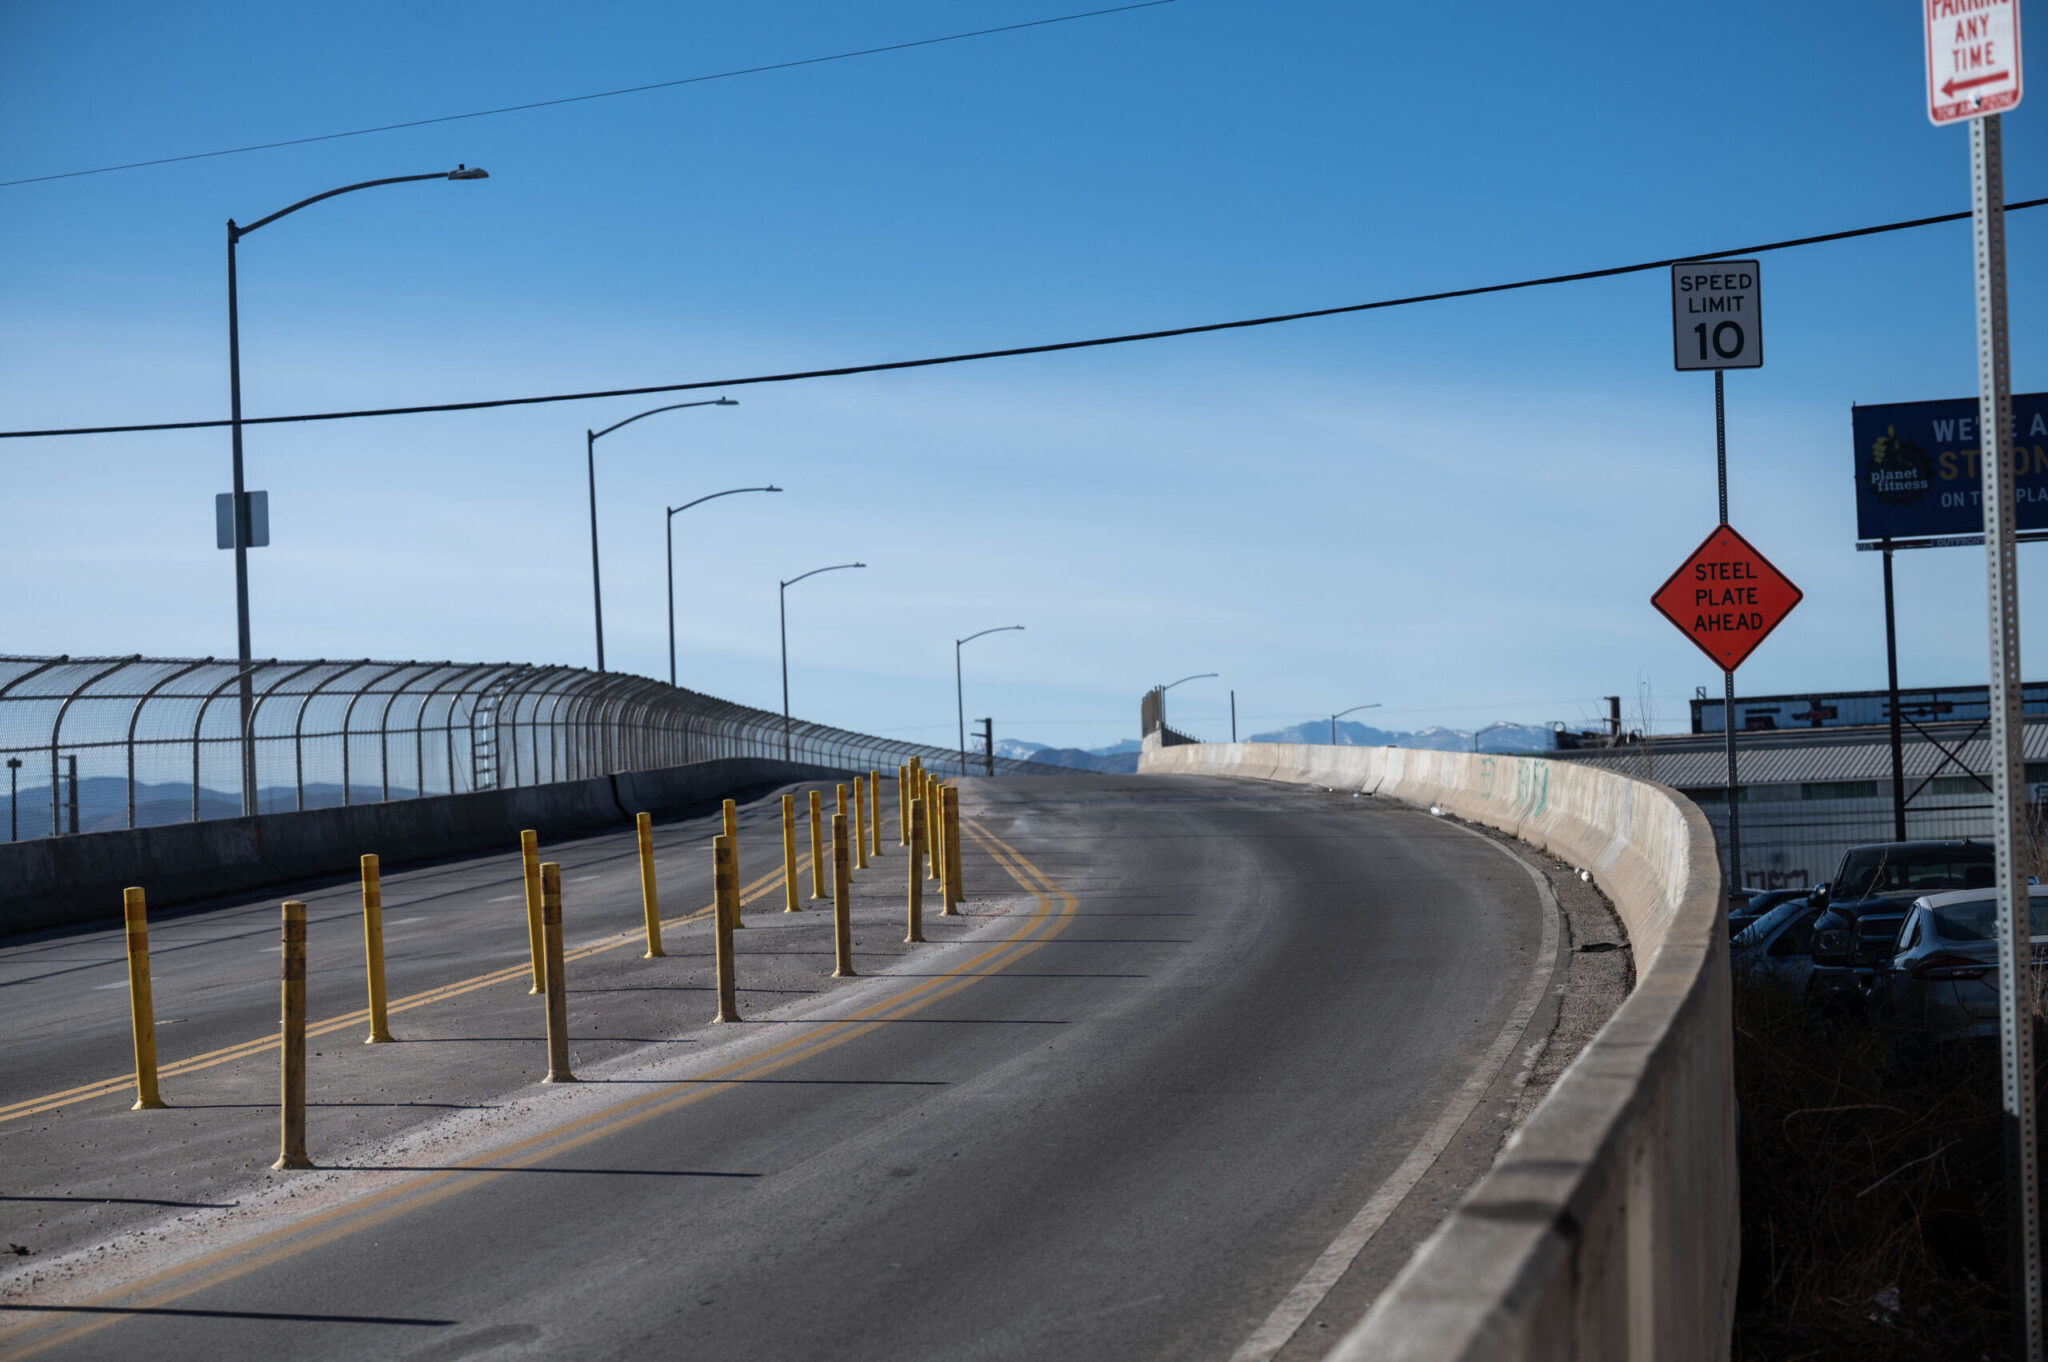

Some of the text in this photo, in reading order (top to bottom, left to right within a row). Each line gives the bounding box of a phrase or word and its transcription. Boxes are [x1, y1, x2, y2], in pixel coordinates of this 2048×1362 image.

[1954, 12, 1989, 43] ANY
[1952, 41, 1995, 72] TIME
[1680, 273, 1753, 292] SPEED
[1689, 296, 1744, 313] LIMIT
[1694, 320, 1745, 360] 10
[1870, 467, 1918, 484] planet
[1877, 479, 1929, 492] fitness
[1940, 491, 1965, 508] ON
[1695, 561, 1758, 581] STEEL
[1695, 587, 1758, 606] PLATE
[1693, 612, 1763, 632] AHEAD
